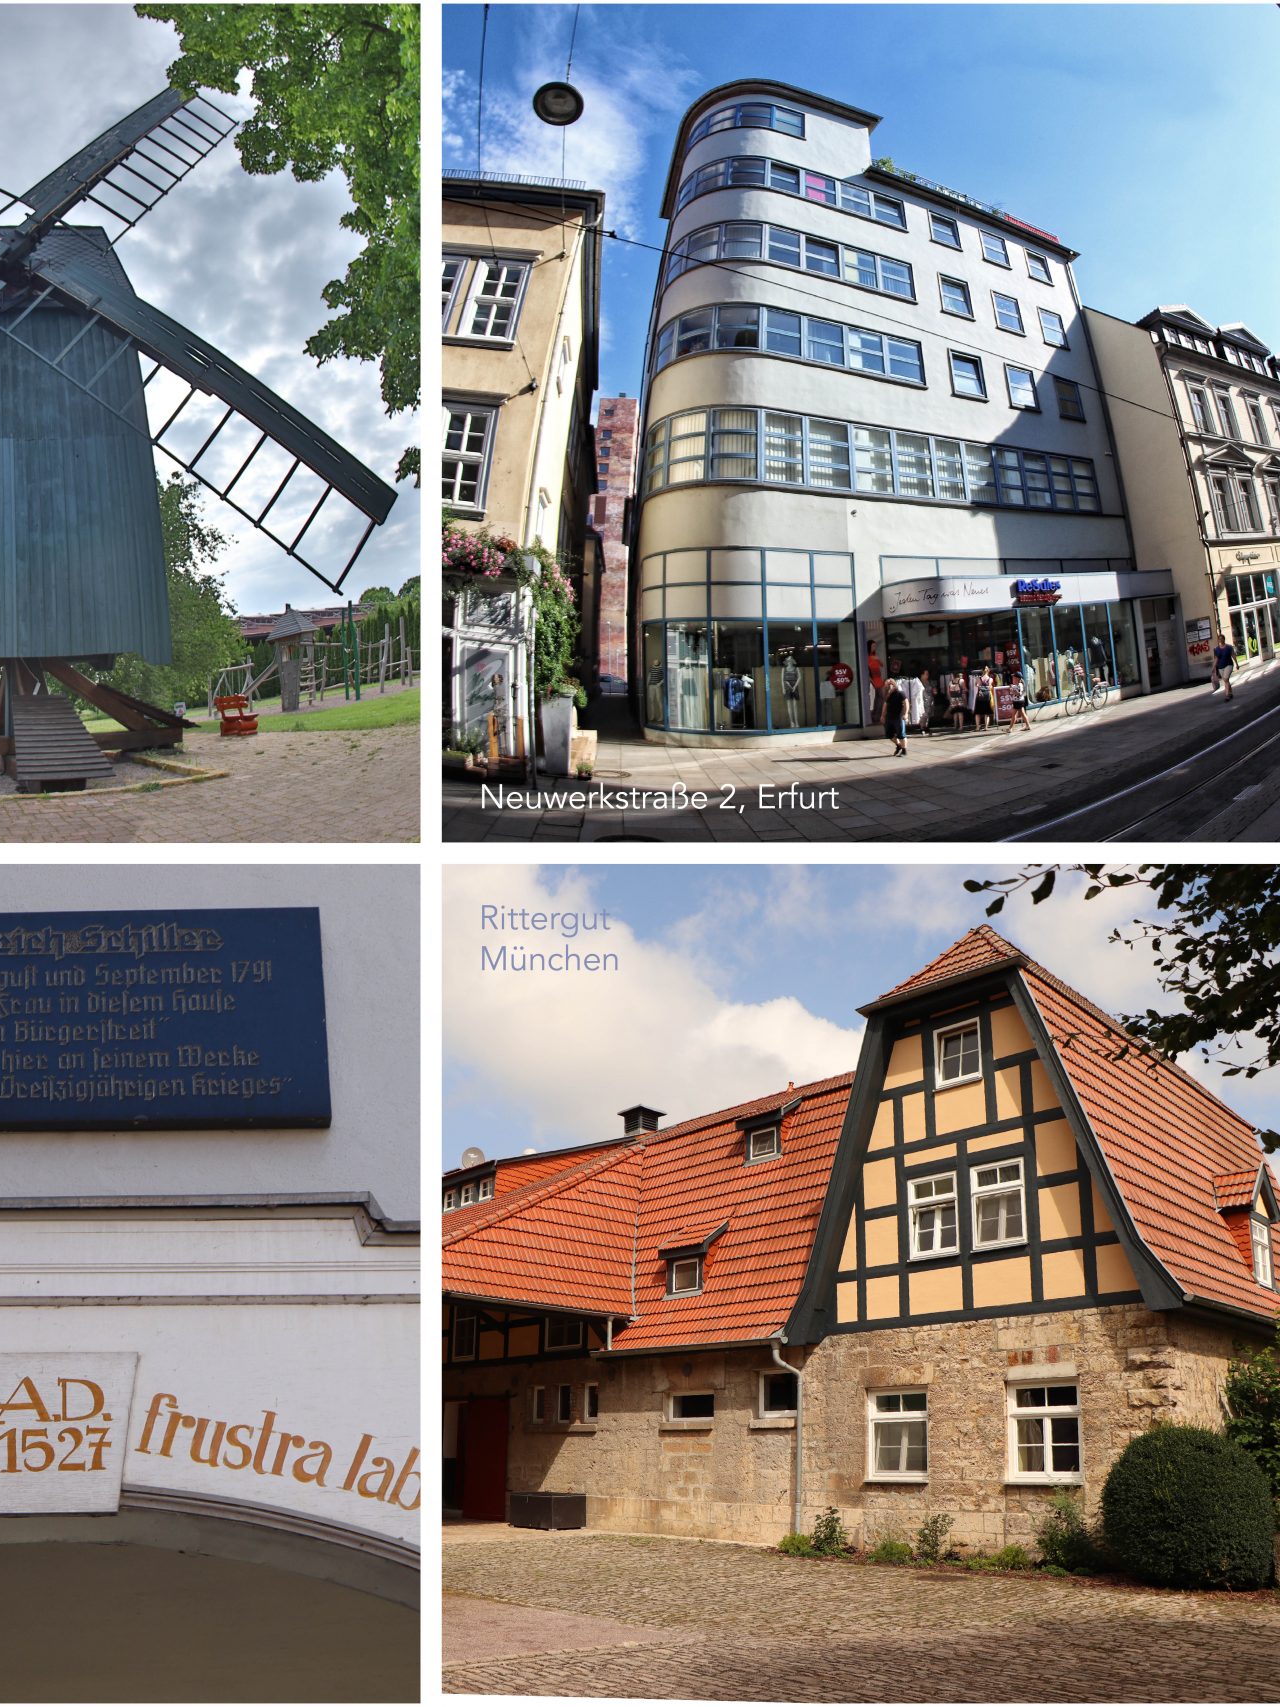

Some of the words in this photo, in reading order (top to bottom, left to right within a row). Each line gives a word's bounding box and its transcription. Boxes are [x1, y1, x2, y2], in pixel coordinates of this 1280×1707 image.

[833, 676, 850, 684] -50%
[79, 921, 225, 959] Schiller
[44, 965, 86, 987] und
[94, 962, 223, 988] September
[230, 959, 272, 984] 1791
[58, 991, 80, 1014] in
[0, 1049, 49, 1073] hier
[57, 1050, 86, 1071] an
[176, 1043, 262, 1069] Werke
[134, 1392, 328, 1488] frustra
